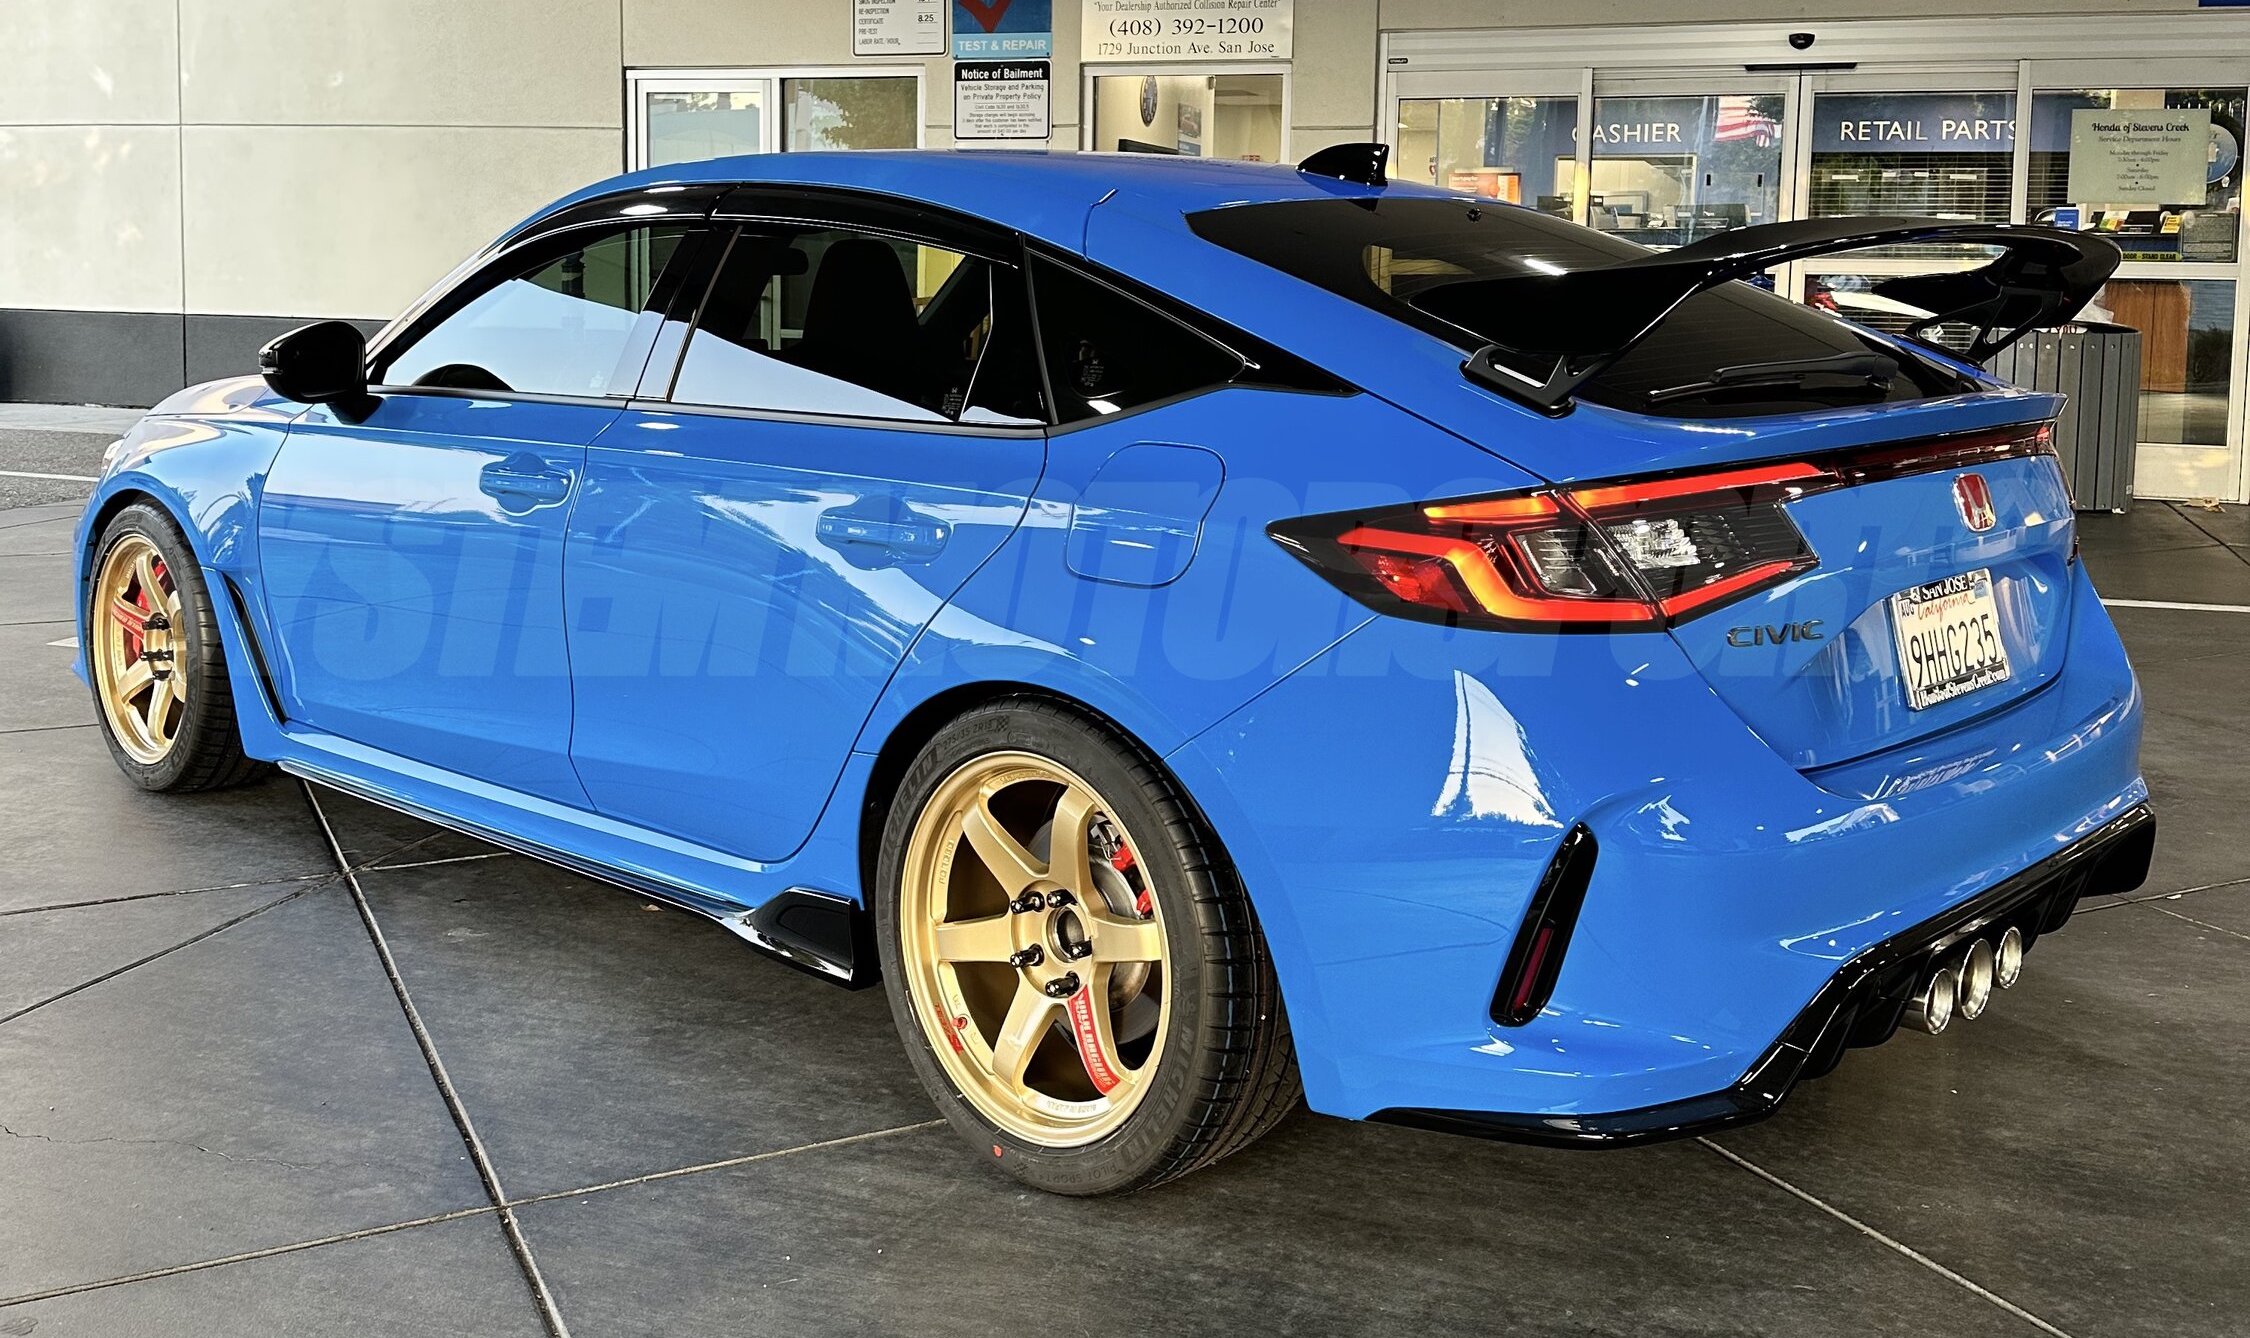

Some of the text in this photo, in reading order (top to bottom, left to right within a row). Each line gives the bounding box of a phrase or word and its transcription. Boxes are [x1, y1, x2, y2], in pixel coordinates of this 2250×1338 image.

[1115, 1, 1152, 13] Dealership
[1154, 0, 1191, 11] Authorized
[1194, 0, 1225, 10] Collision
[1228, 0, 1251, 11] Repair
[1109, 17, 1264, 38] (408) 392-1200
[958, 39, 1047, 51] TEST & REPAIR
[1098, 40, 1275, 55] 1729 Junction Ave. San Jose
[961, 68, 1043, 80] Notice of Bailment
[984, 84, 1006, 92] Storage
[1020, 83, 1044, 92] Parking
[996, 93, 1020, 101] Property
[1840, 120, 1929, 141] RETAIL
[2092, 122, 2190, 134] Honda of Stevens Creek
[1922, 574, 1968, 600] SAN JOSE
[1900, 592, 1977, 622] AUG California
[1727, 619, 1825, 648] CIVIC
[1910, 613, 1998, 689] 9HHG235
[1126, 1025, 1195, 1162] MICHELIN
